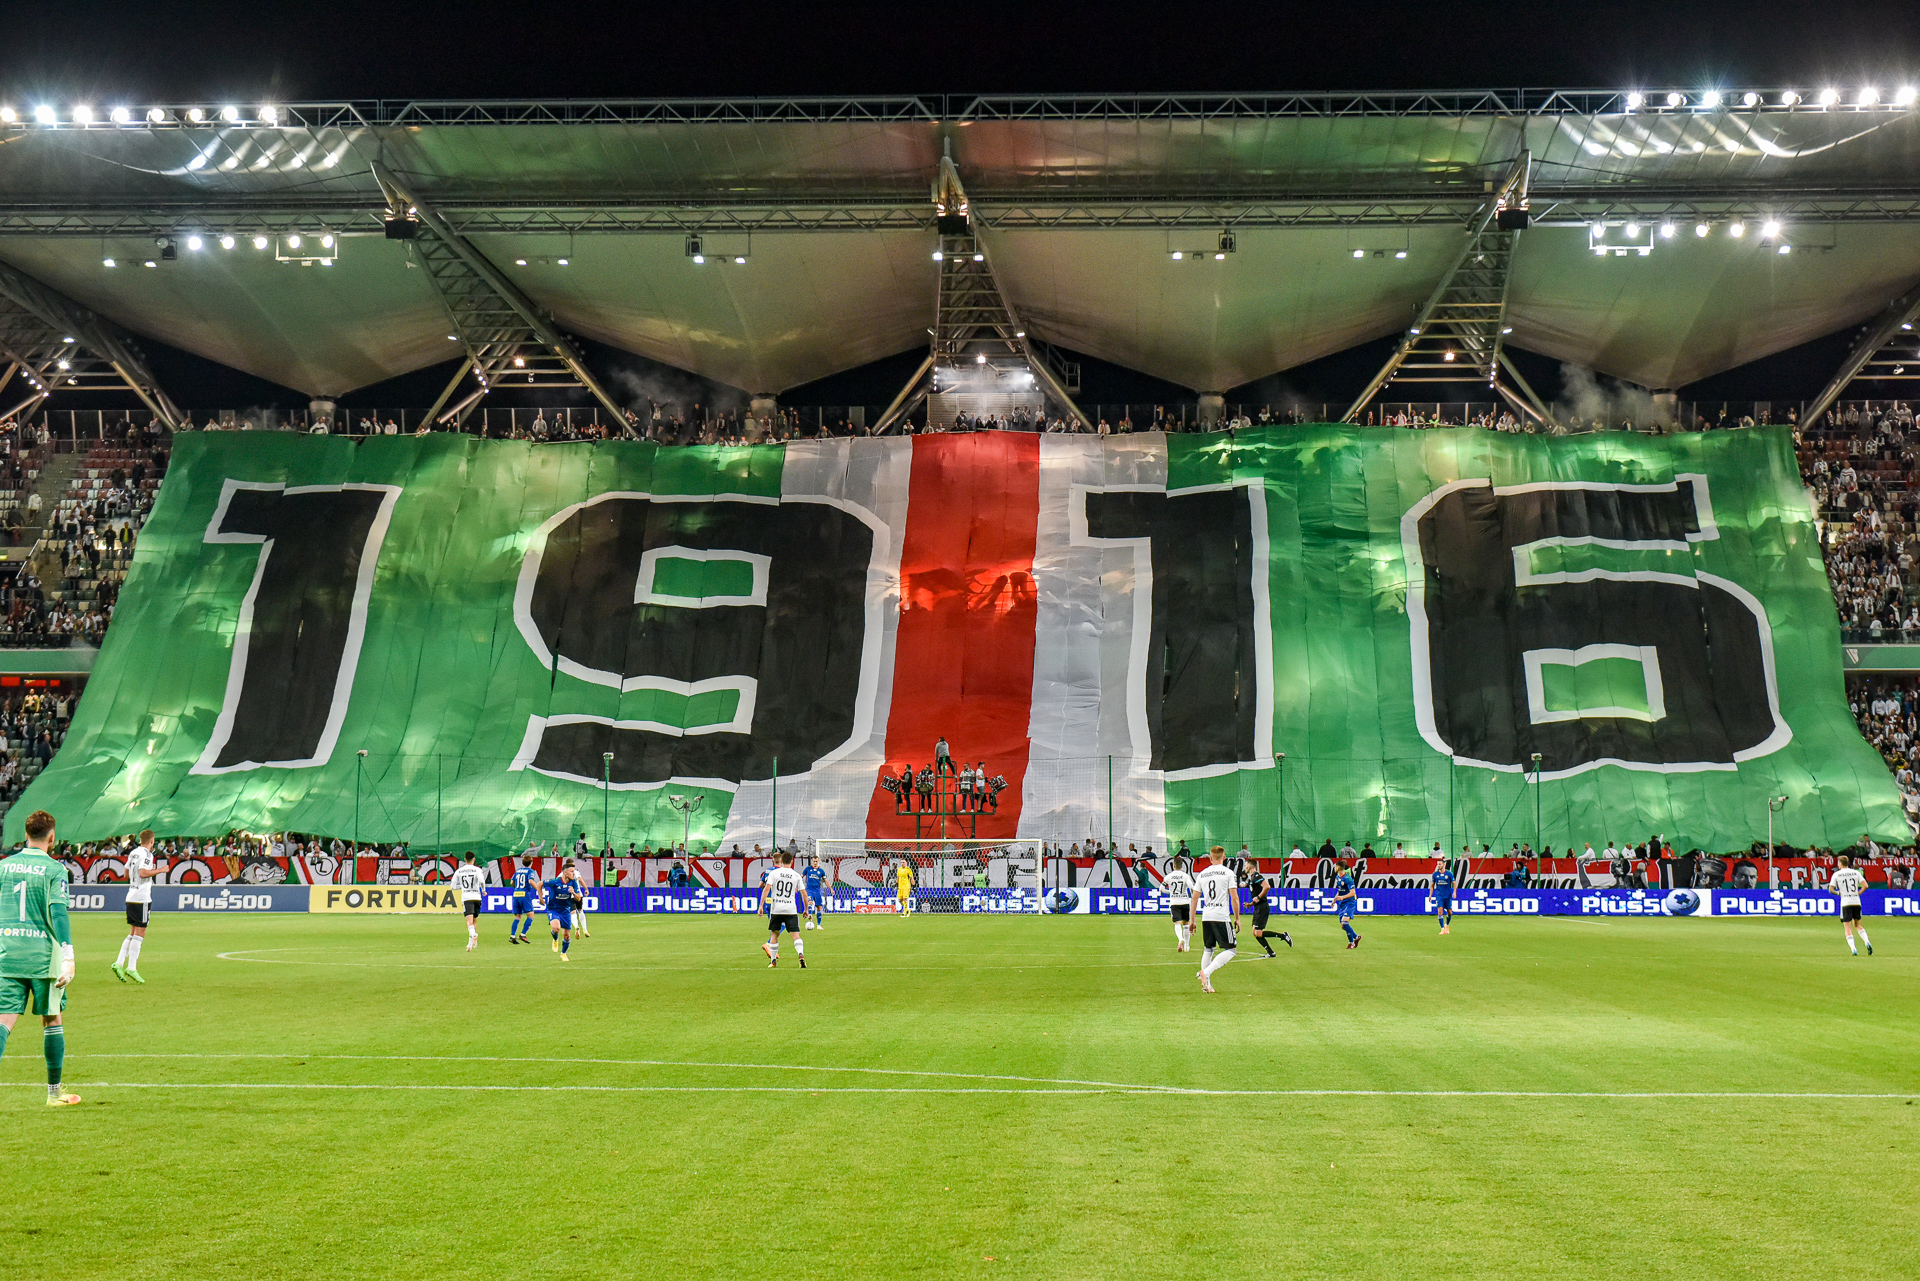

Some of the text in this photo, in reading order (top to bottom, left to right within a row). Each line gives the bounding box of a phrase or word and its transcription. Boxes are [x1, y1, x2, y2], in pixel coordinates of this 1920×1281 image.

[3, 863, 47, 876] TOBIASZ
[461, 875, 475, 889] 67
[515, 873, 526, 889] 19
[776, 880, 793, 898] 99
[1171, 881, 1184, 895] 27
[1208, 880, 1216, 900] 8
[1842, 878, 1857, 893] 13
[13, 881, 27, 921] 1
[178, 889, 272, 909] Plus500
[327, 889, 458, 908] FORTUNA
[646, 888, 758, 911] Plus500
[1424, 889, 1539, 912] Pus500
[1720, 889, 1835, 914] Plus500
[0, 928, 48, 938] FORTUNA
